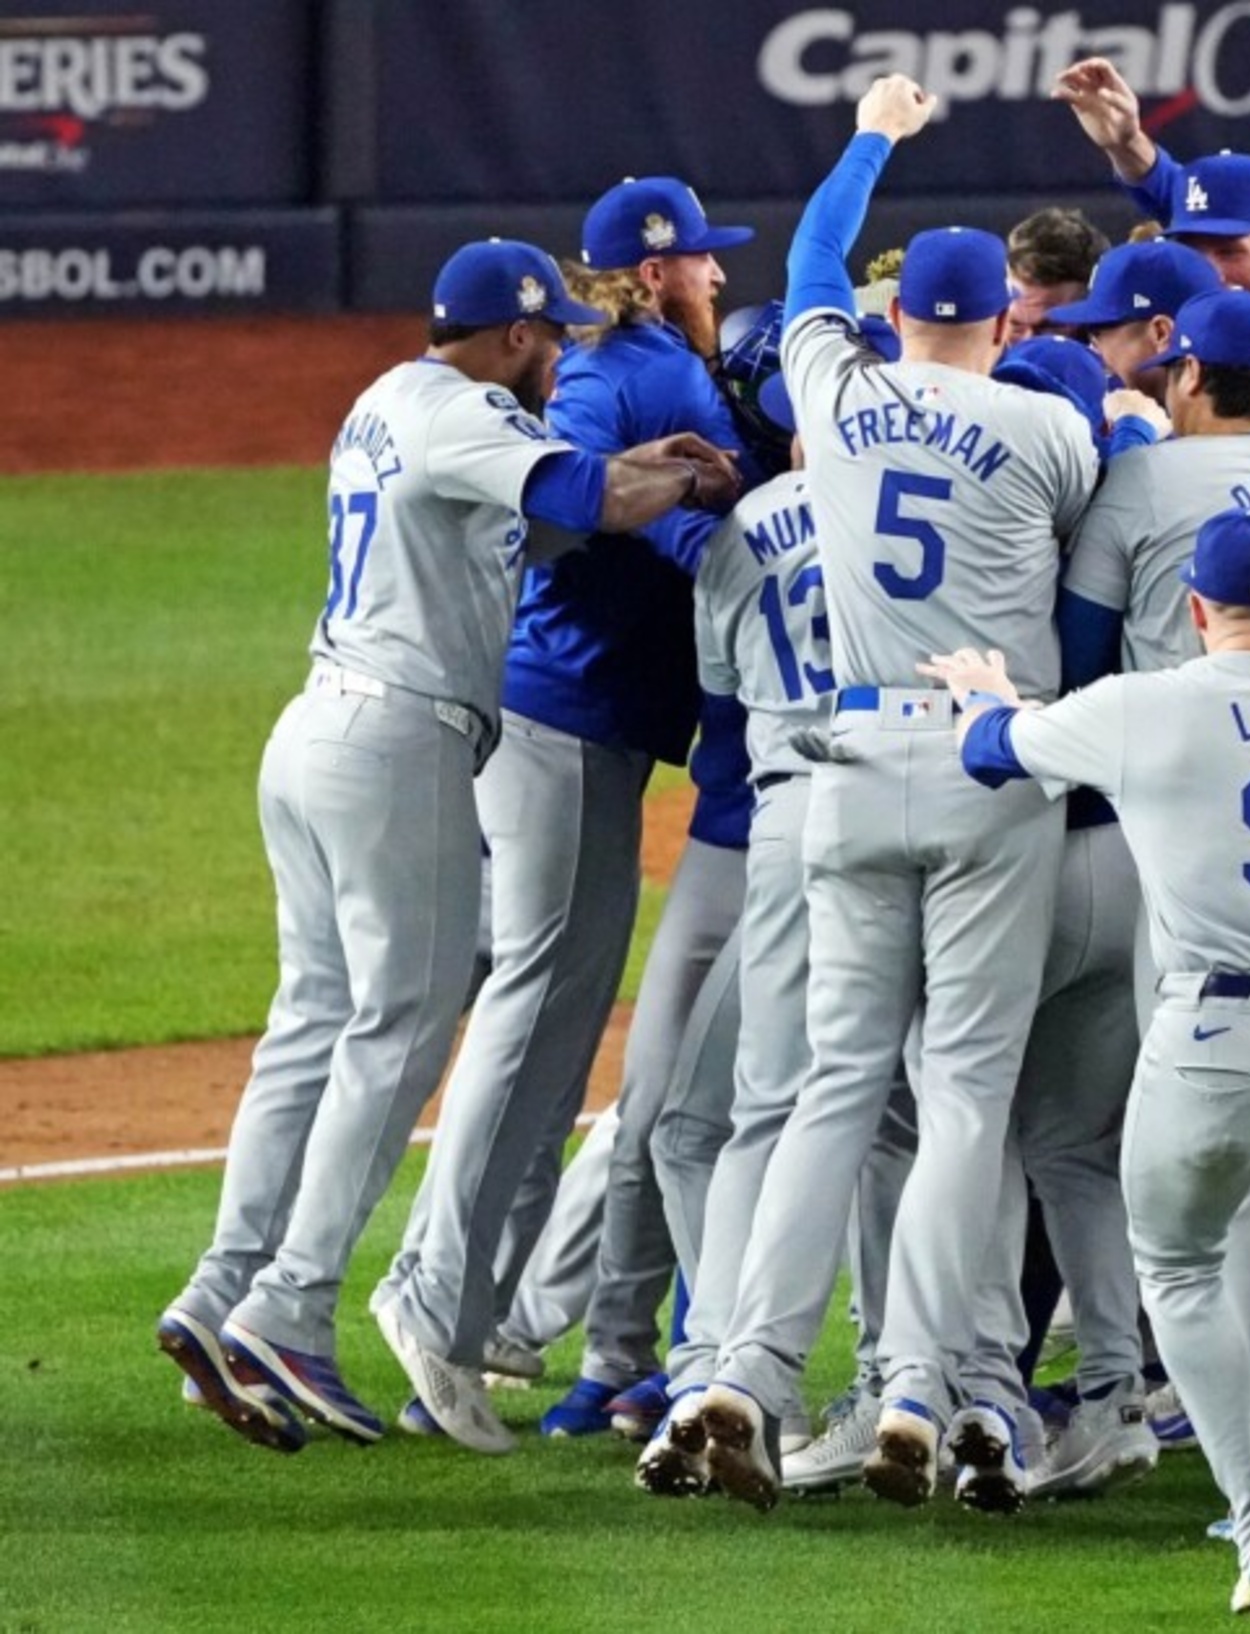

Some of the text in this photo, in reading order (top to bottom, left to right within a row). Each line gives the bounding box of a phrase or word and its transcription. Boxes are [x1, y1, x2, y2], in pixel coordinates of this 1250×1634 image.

[837, 402, 1012, 483] FREEMAN
[743, 502, 816, 567] MUN
[873, 468, 953, 600] 5
[759, 565, 838, 703] 13
